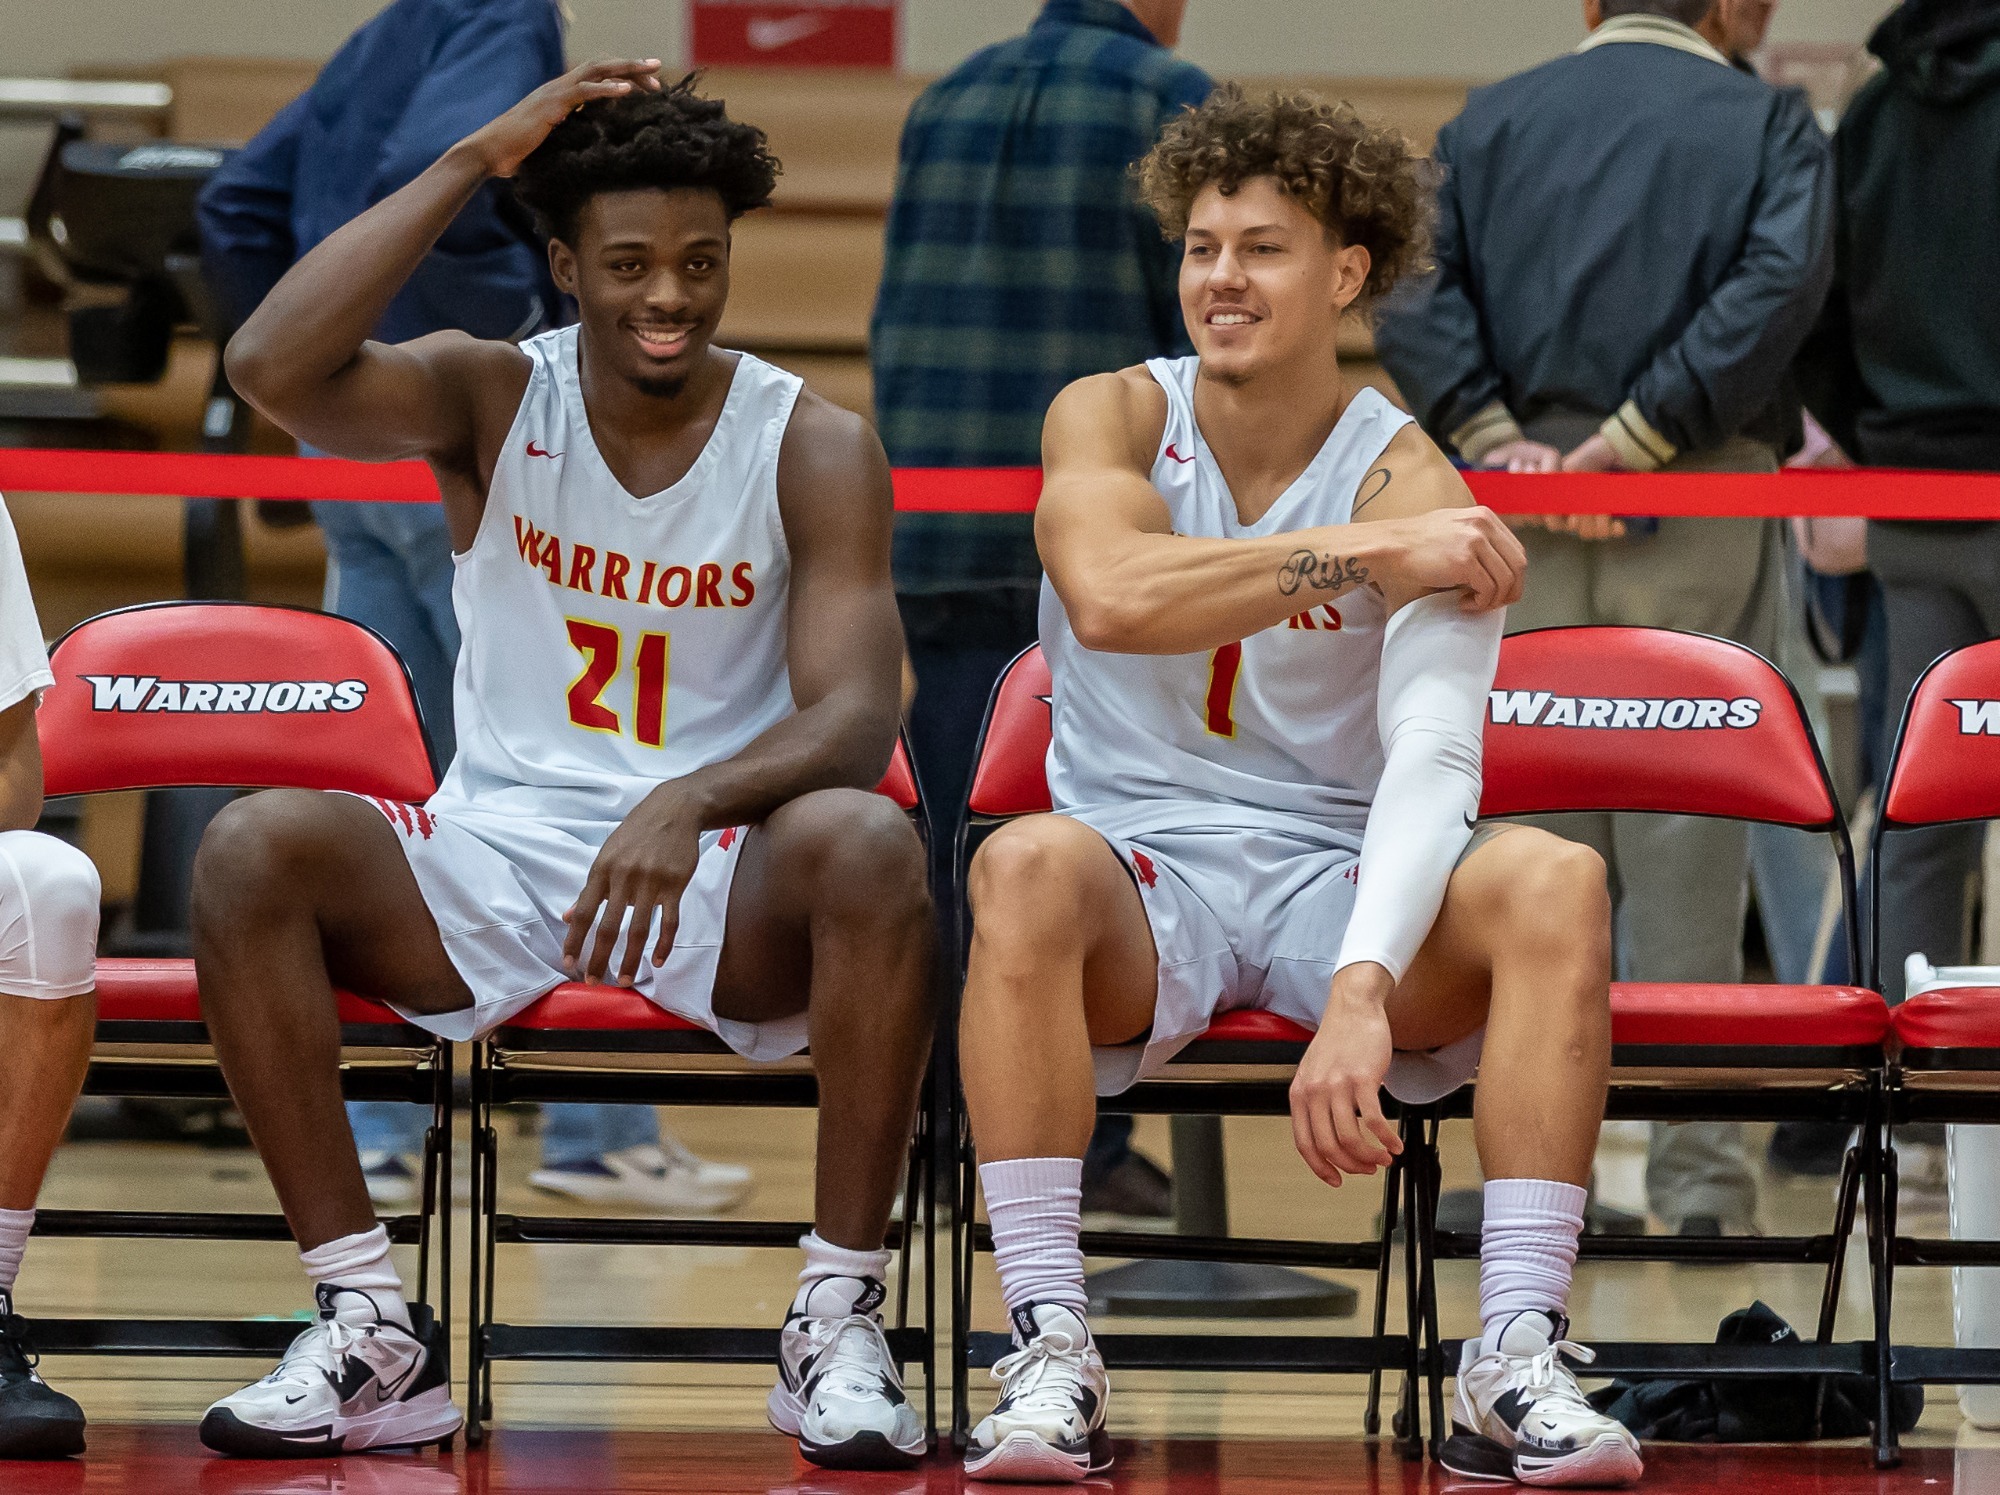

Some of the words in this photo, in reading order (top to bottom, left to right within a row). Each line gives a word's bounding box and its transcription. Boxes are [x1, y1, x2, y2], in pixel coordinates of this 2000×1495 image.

[513, 514, 756, 608] WARRIORS
[1277, 549, 1370, 596] Rise
[80, 675, 368, 713] WARRIORS
[564, 615, 669, 750] 21
[1206, 640, 1242, 739] 1
[1488, 689, 1762, 730] WARRIORS
